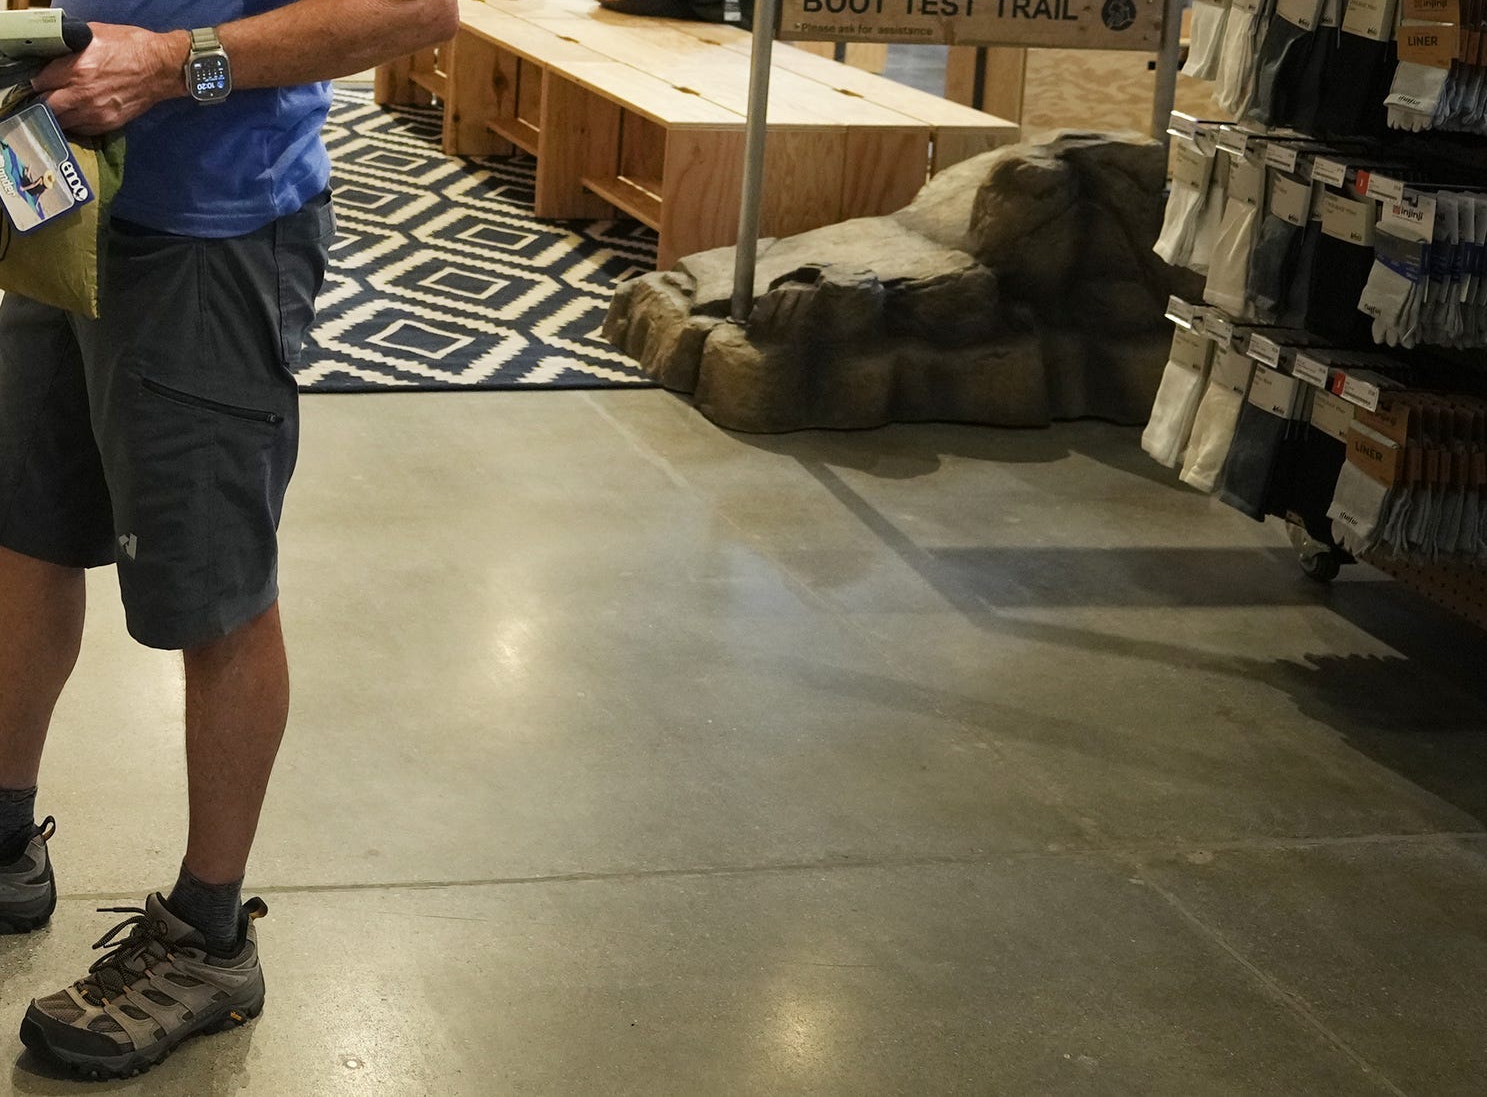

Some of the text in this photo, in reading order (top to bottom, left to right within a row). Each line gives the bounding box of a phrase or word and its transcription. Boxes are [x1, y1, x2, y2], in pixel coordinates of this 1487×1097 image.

[801, 23, 934, 37] Please ask for assistance
[1407, 36, 1438, 47] LINER
[1401, 206, 1424, 222] injinji
[1354, 440, 1384, 463] LINER
